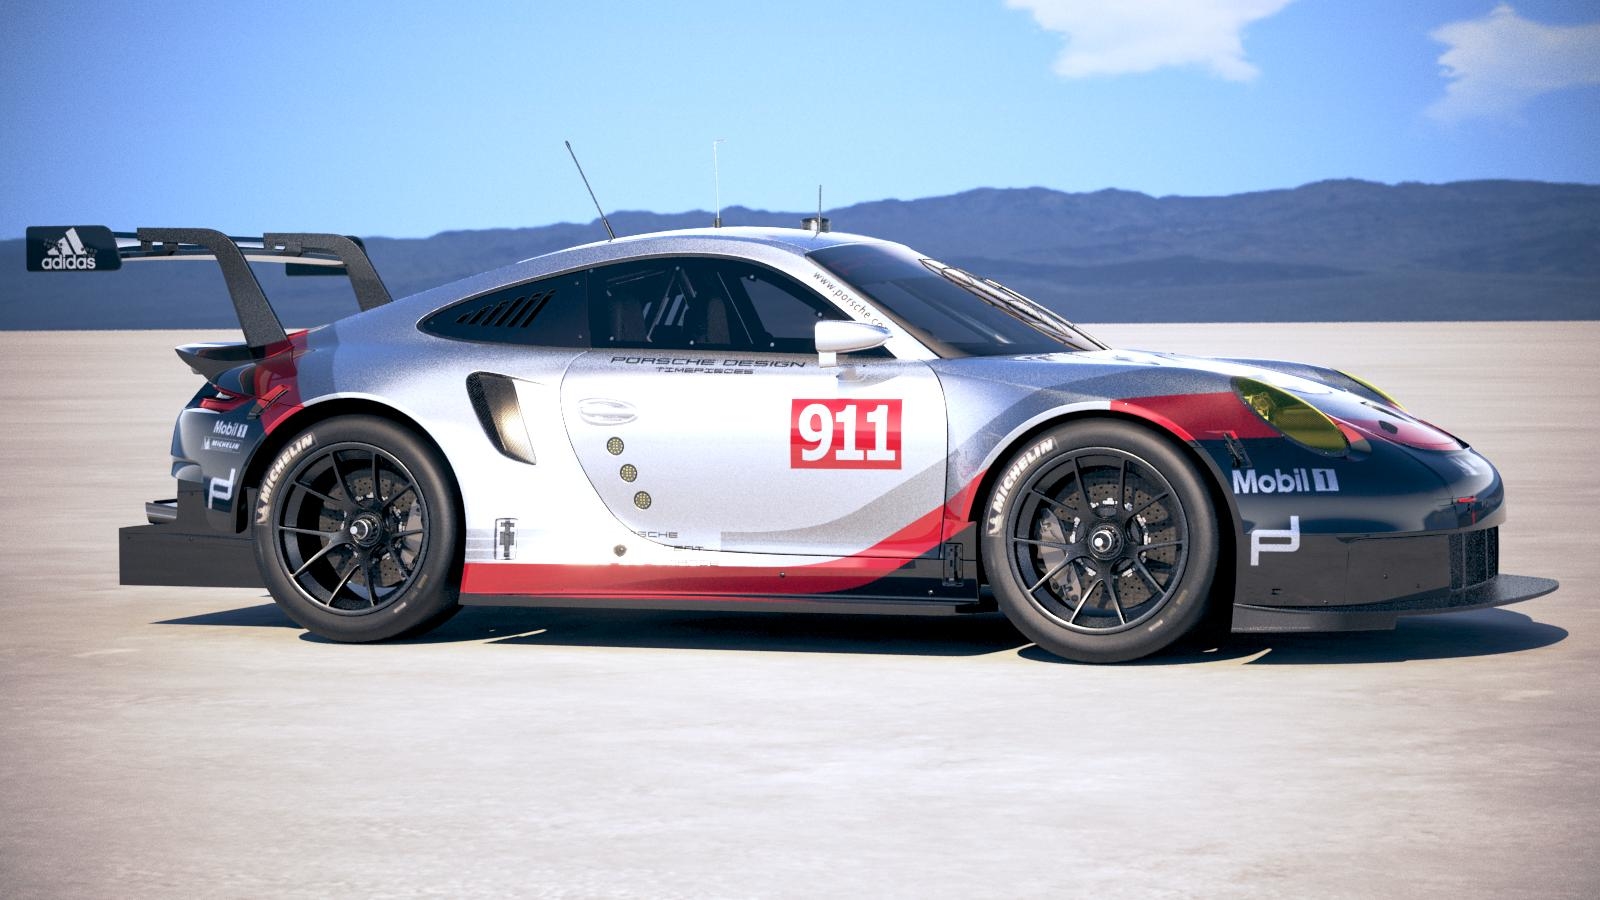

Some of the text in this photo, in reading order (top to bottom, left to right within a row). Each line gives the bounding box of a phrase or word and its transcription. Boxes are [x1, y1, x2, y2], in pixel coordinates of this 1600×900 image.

[41, 254, 96, 269] adidas
[813, 271, 888, 330] www.porsche.co
[610, 356, 806, 368] PORSCHE DESIGN
[656, 366, 754, 375] TIMEPIECES
[213, 420, 238, 436] Mobil
[798, 403, 896, 461] 911
[211, 439, 240, 449] MICHELIN
[260, 434, 313, 504] MICHELIN
[992, 438, 1053, 513] MICHELIN
[1232, 468, 1336, 494] Mobil 1
